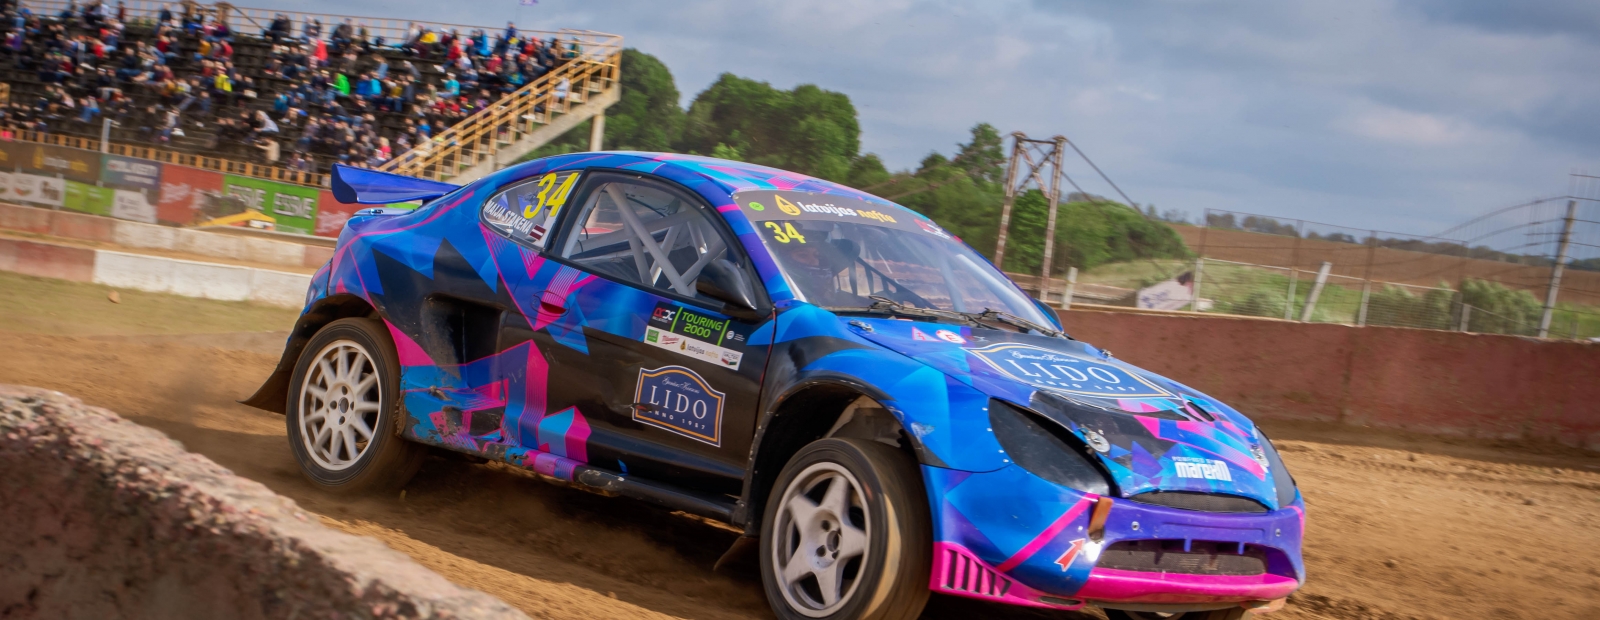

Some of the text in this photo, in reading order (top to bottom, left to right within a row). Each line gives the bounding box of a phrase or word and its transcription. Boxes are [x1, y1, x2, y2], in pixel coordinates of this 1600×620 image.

[523, 172, 579, 219] 34
[483, 200, 533, 235] MAIJA STAKENA
[796, 201, 897, 223] latvijas nafta
[764, 221, 806, 244] 34
[681, 311, 723, 331] TOURING
[683, 322, 711, 338] 2000
[1003, 358, 1121, 384] LIDO
[649, 385, 707, 419] LIDO
